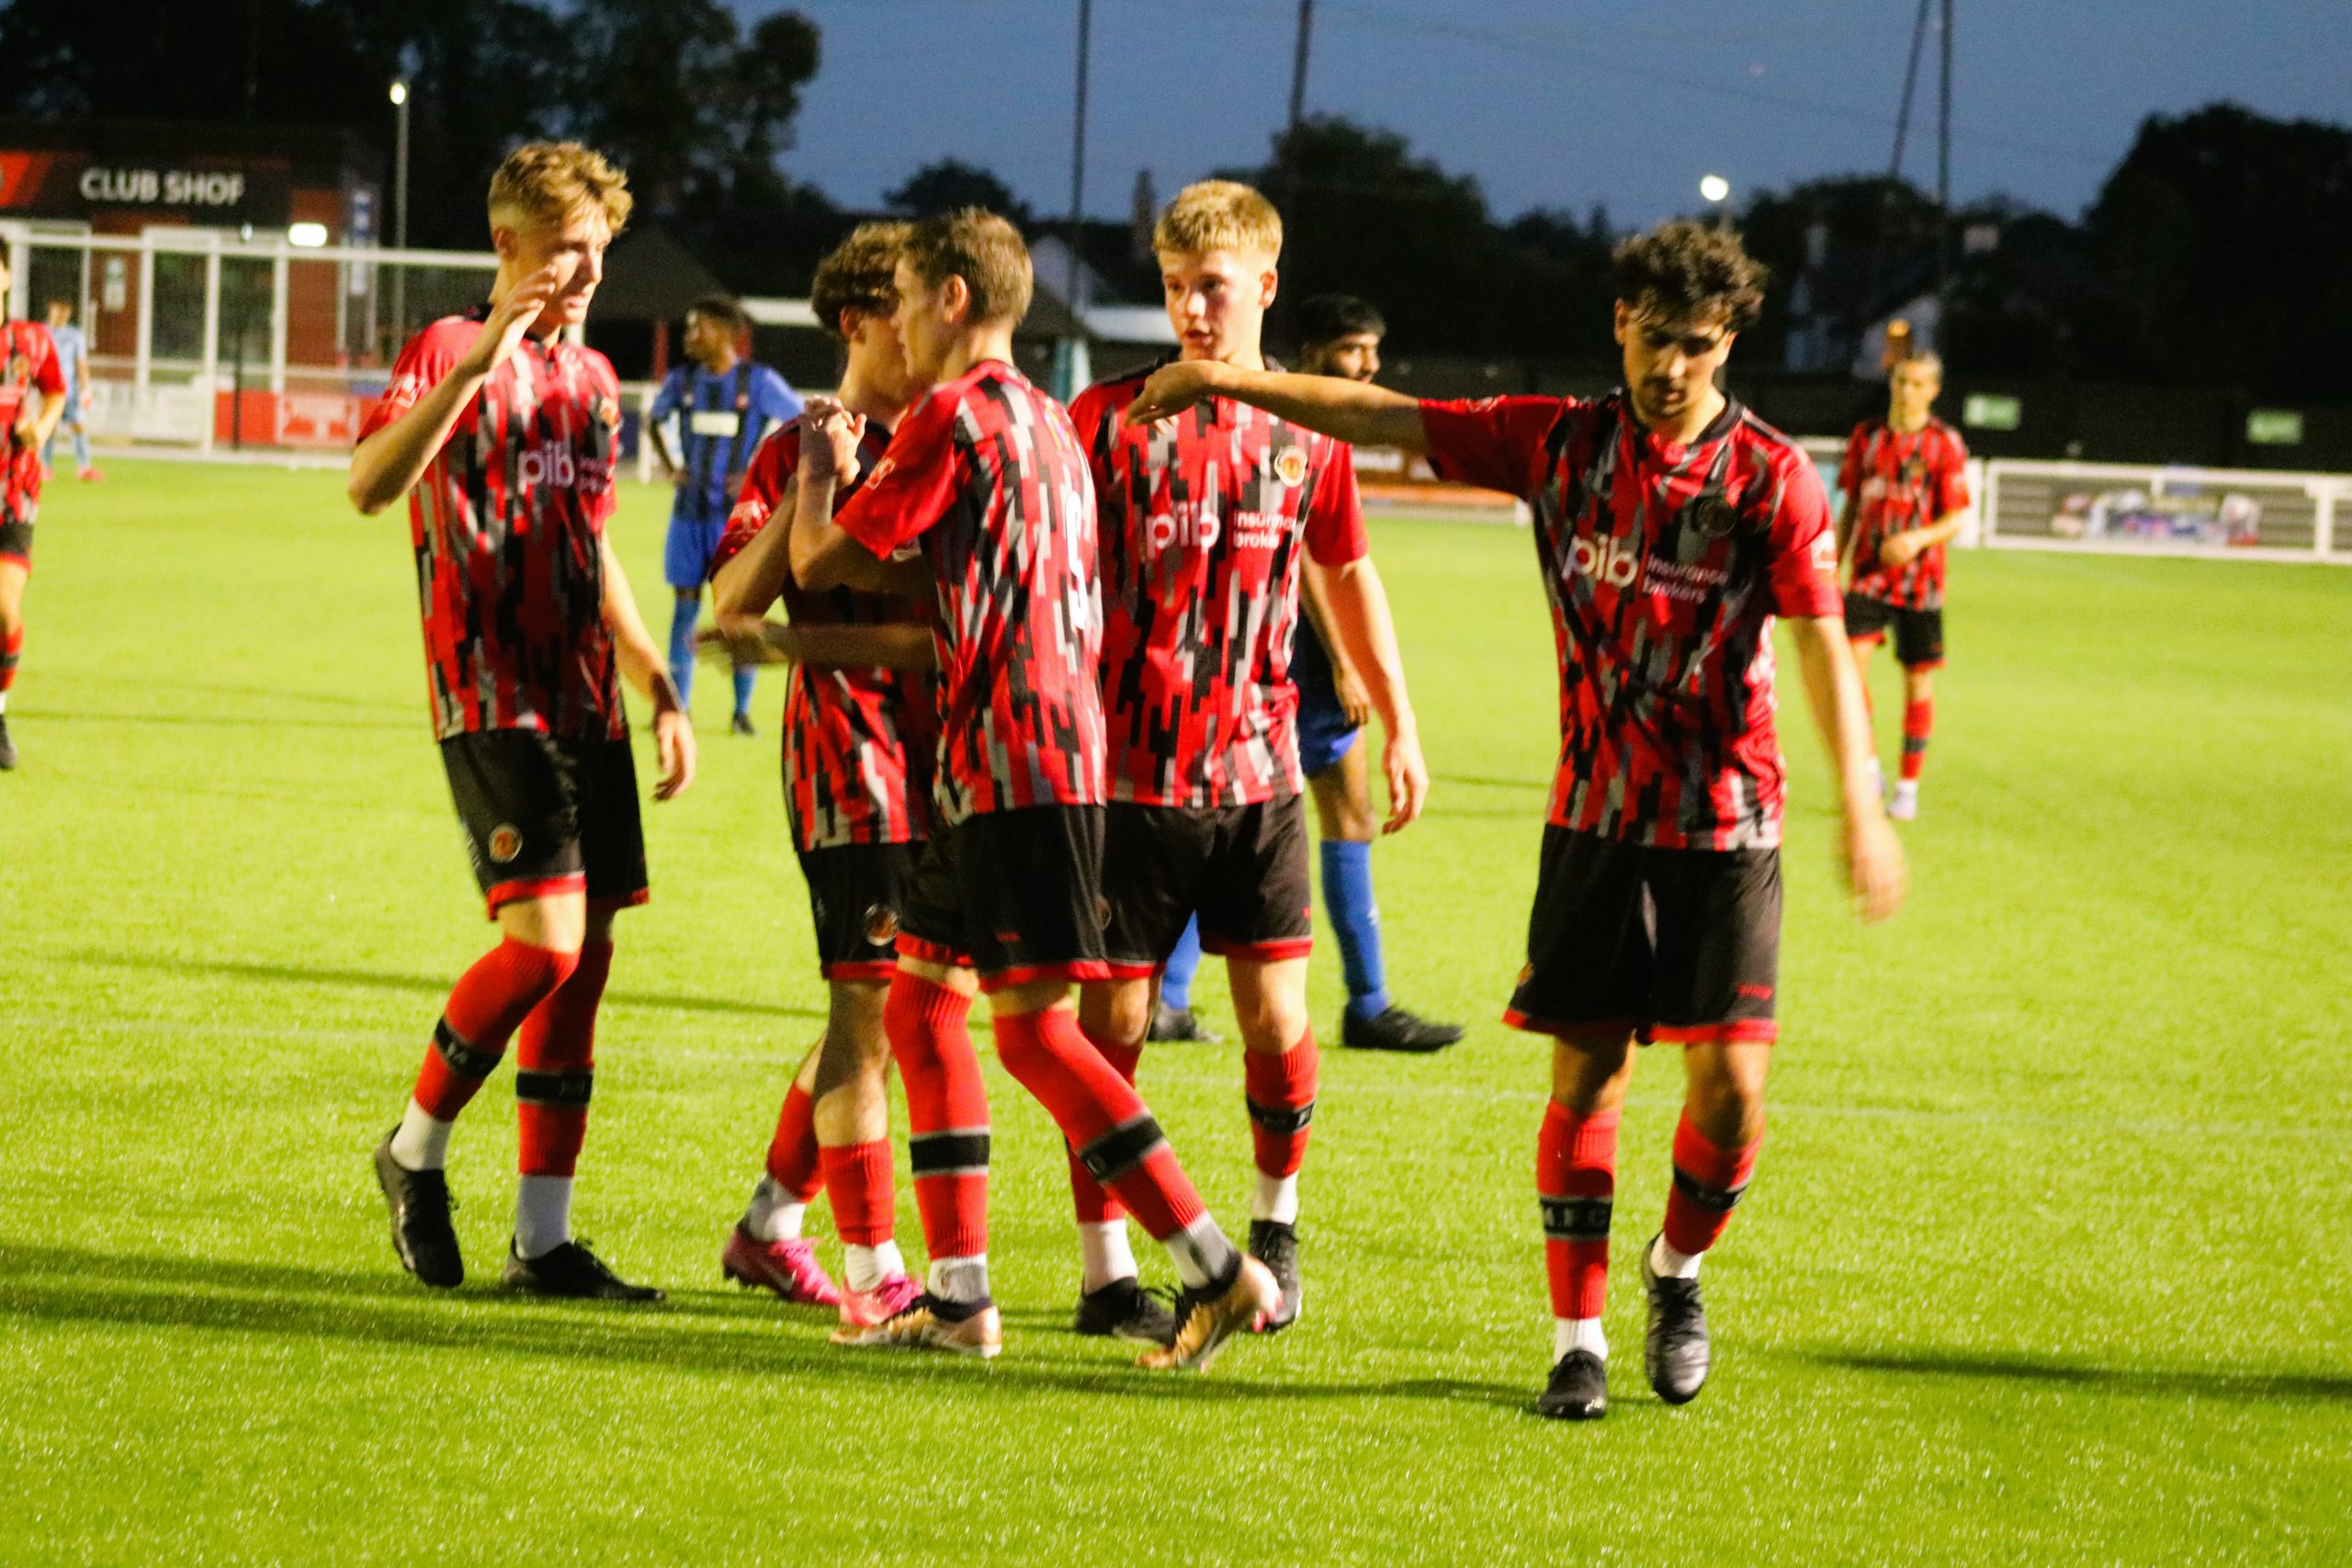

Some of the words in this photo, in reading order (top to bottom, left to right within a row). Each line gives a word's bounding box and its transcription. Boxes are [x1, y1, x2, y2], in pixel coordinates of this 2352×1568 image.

[79, 167, 159, 203] CLUB
[164, 170, 245, 206] SHOP
[517, 439, 574, 496] pib
[1146, 501, 1221, 559] pib
[1563, 533, 1639, 591] pib
